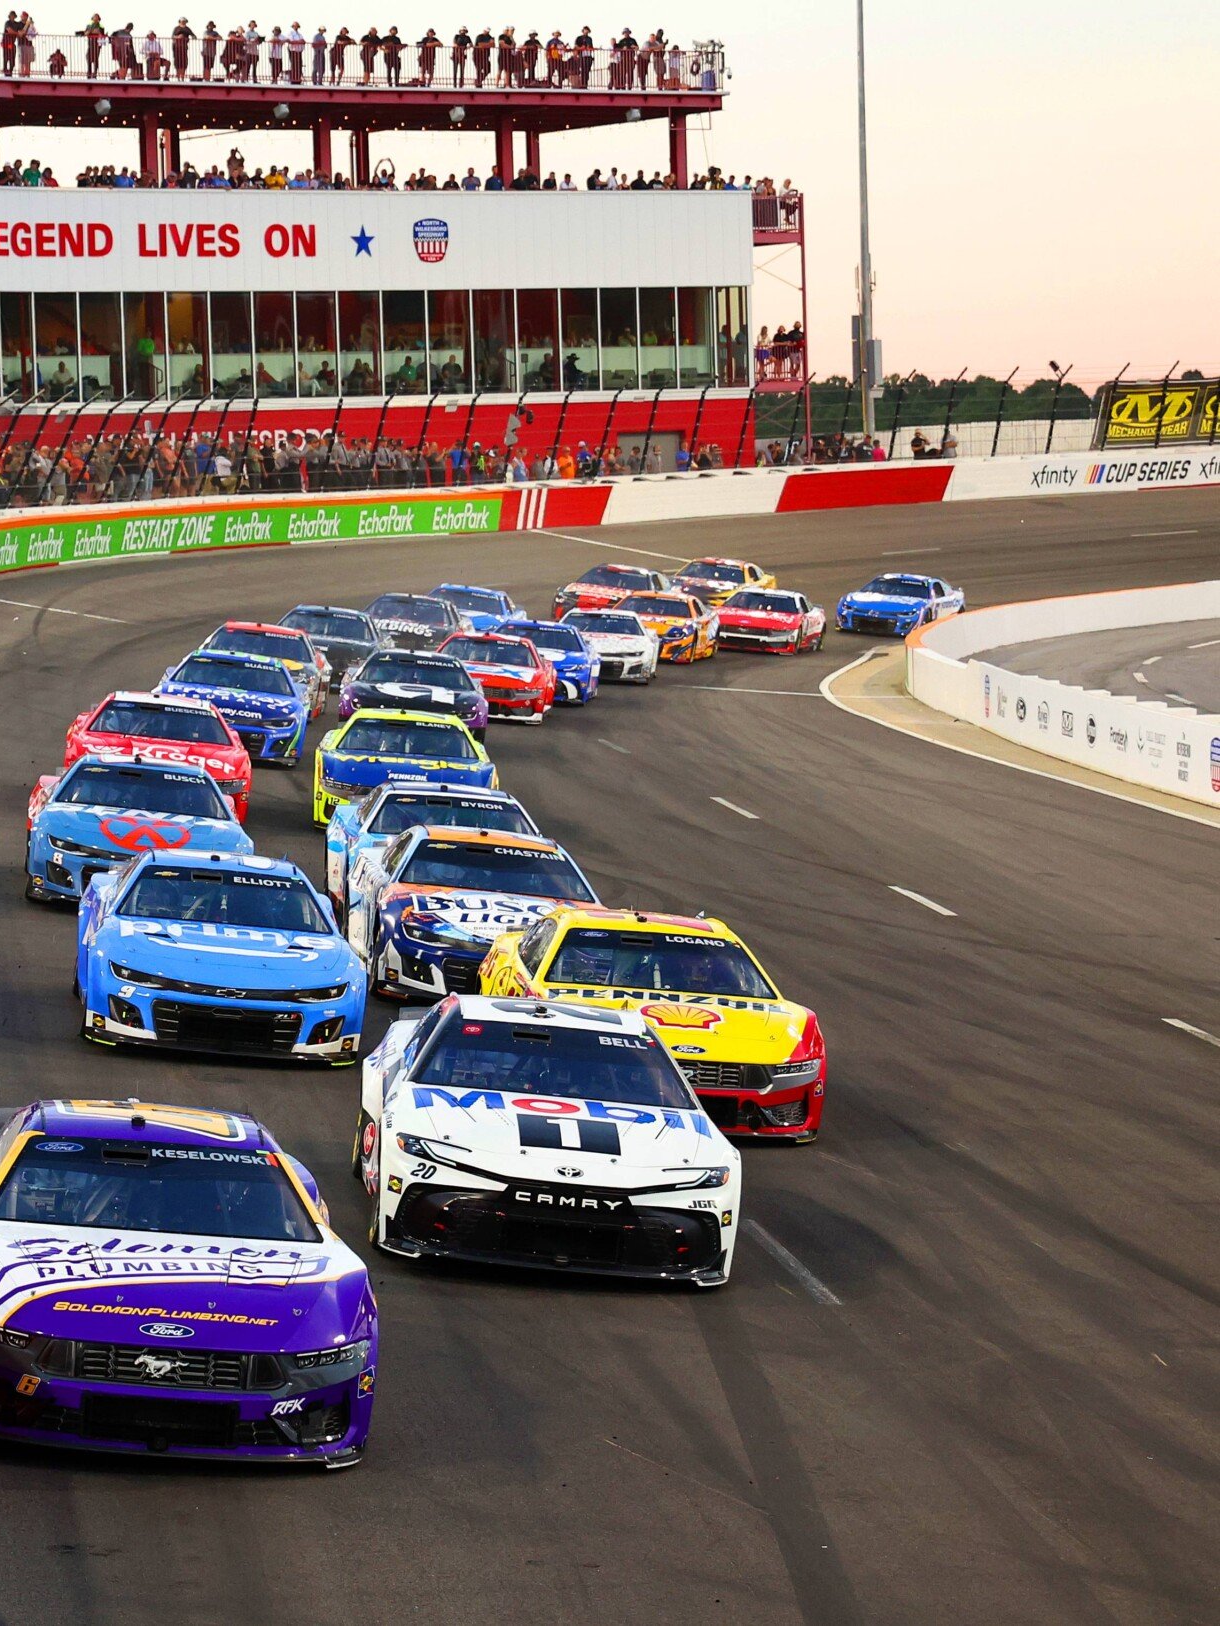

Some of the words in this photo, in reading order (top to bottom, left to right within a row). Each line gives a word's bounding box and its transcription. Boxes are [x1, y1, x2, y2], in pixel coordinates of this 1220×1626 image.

[138, 223, 240, 258] LIVES
[264, 224, 316, 258] ON
[1108, 424, 1157, 438] MECHANIX
[1031, 464, 1078, 488] xfinity
[1106, 463, 1137, 483] CUP
[1137, 460, 1191, 482] SERIES
[287, 509, 341, 539] EchoPark
[357, 505, 416, 536] EchoPark
[432, 502, 490, 531] EchoPark
[121, 518, 179, 551] RESTART
[177, 515, 216, 547] ZONE
[224, 511, 273, 543] EchoPark
[27, 527, 64, 562] EchoPark
[73, 523, 112, 557] EchoPark
[416, 659, 455, 668] BOWMAN
[176, 693, 290, 715] NSURANCE
[218, 707, 263, 720] way.com
[415, 721, 452, 730] BLANEY
[132, 745, 235, 775] Kroger
[163, 773, 206, 785] BUSCH
[387, 772, 428, 782] PENNZOIL
[461, 801, 503, 811] BYRON
[52, 852, 64, 866] 8
[494, 847, 565, 862] CHASTAIN
[233, 876, 292, 889] ELLIOTT
[417, 895, 552, 917] BUSC
[120, 920, 336, 949] prime
[665, 935, 725, 948] LOGANO
[118, 985, 136, 998] 9
[598, 1035, 648, 1050] BELL
[677, 1045, 702, 1054] Ford
[412, 1087, 713, 1140] Mobil
[547, 1118, 582, 1149] 1
[41, 1142, 80, 1153] Ford
[151, 1147, 273, 1166] KESELOWSKI
[410, 1162, 438, 1180] 20
[515, 1191, 624, 1211] CAMRY
[688, 1200, 718, 1209] JGR
[7, 1238, 319, 1261] Solomon
[38, 1260, 265, 1279] PLUMBING
[52, 1301, 279, 1327] SOLOMONPLUMBING.NET
[148, 1322, 187, 1337] Ford
[17, 1374, 41, 1396] 6
[271, 1398, 306, 1416] RFK
